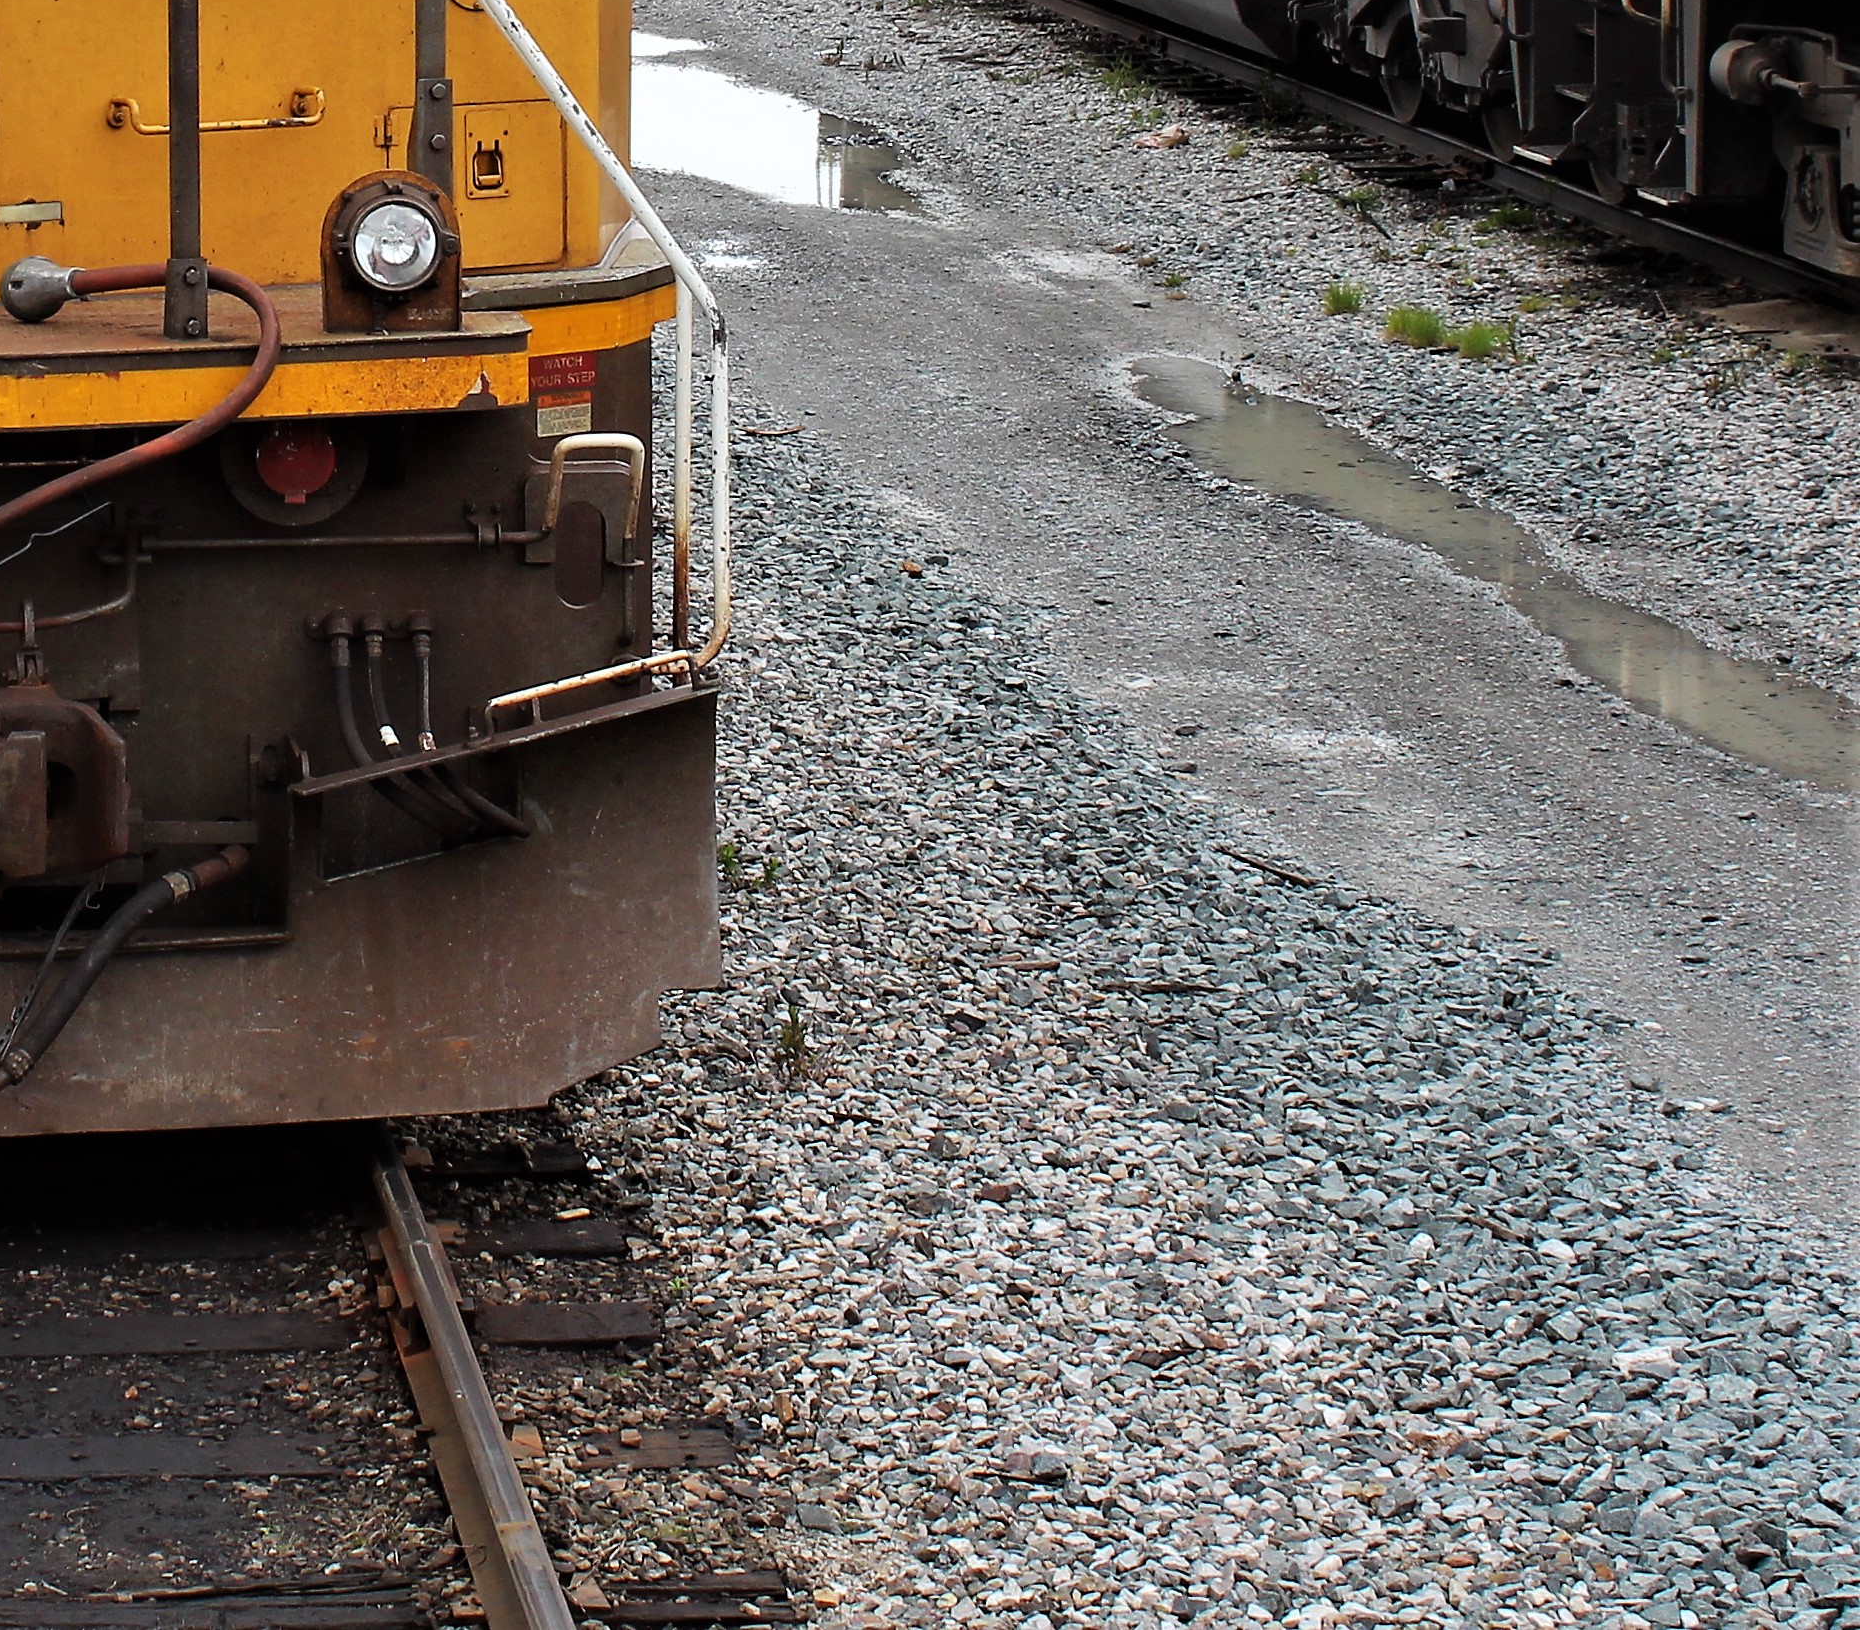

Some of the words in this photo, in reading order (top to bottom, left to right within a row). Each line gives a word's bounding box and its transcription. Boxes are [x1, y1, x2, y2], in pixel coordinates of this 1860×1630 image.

[544, 355, 583, 370] WATCH
[531, 374, 561, 388] YOUR
[567, 371, 596, 384] STEP
